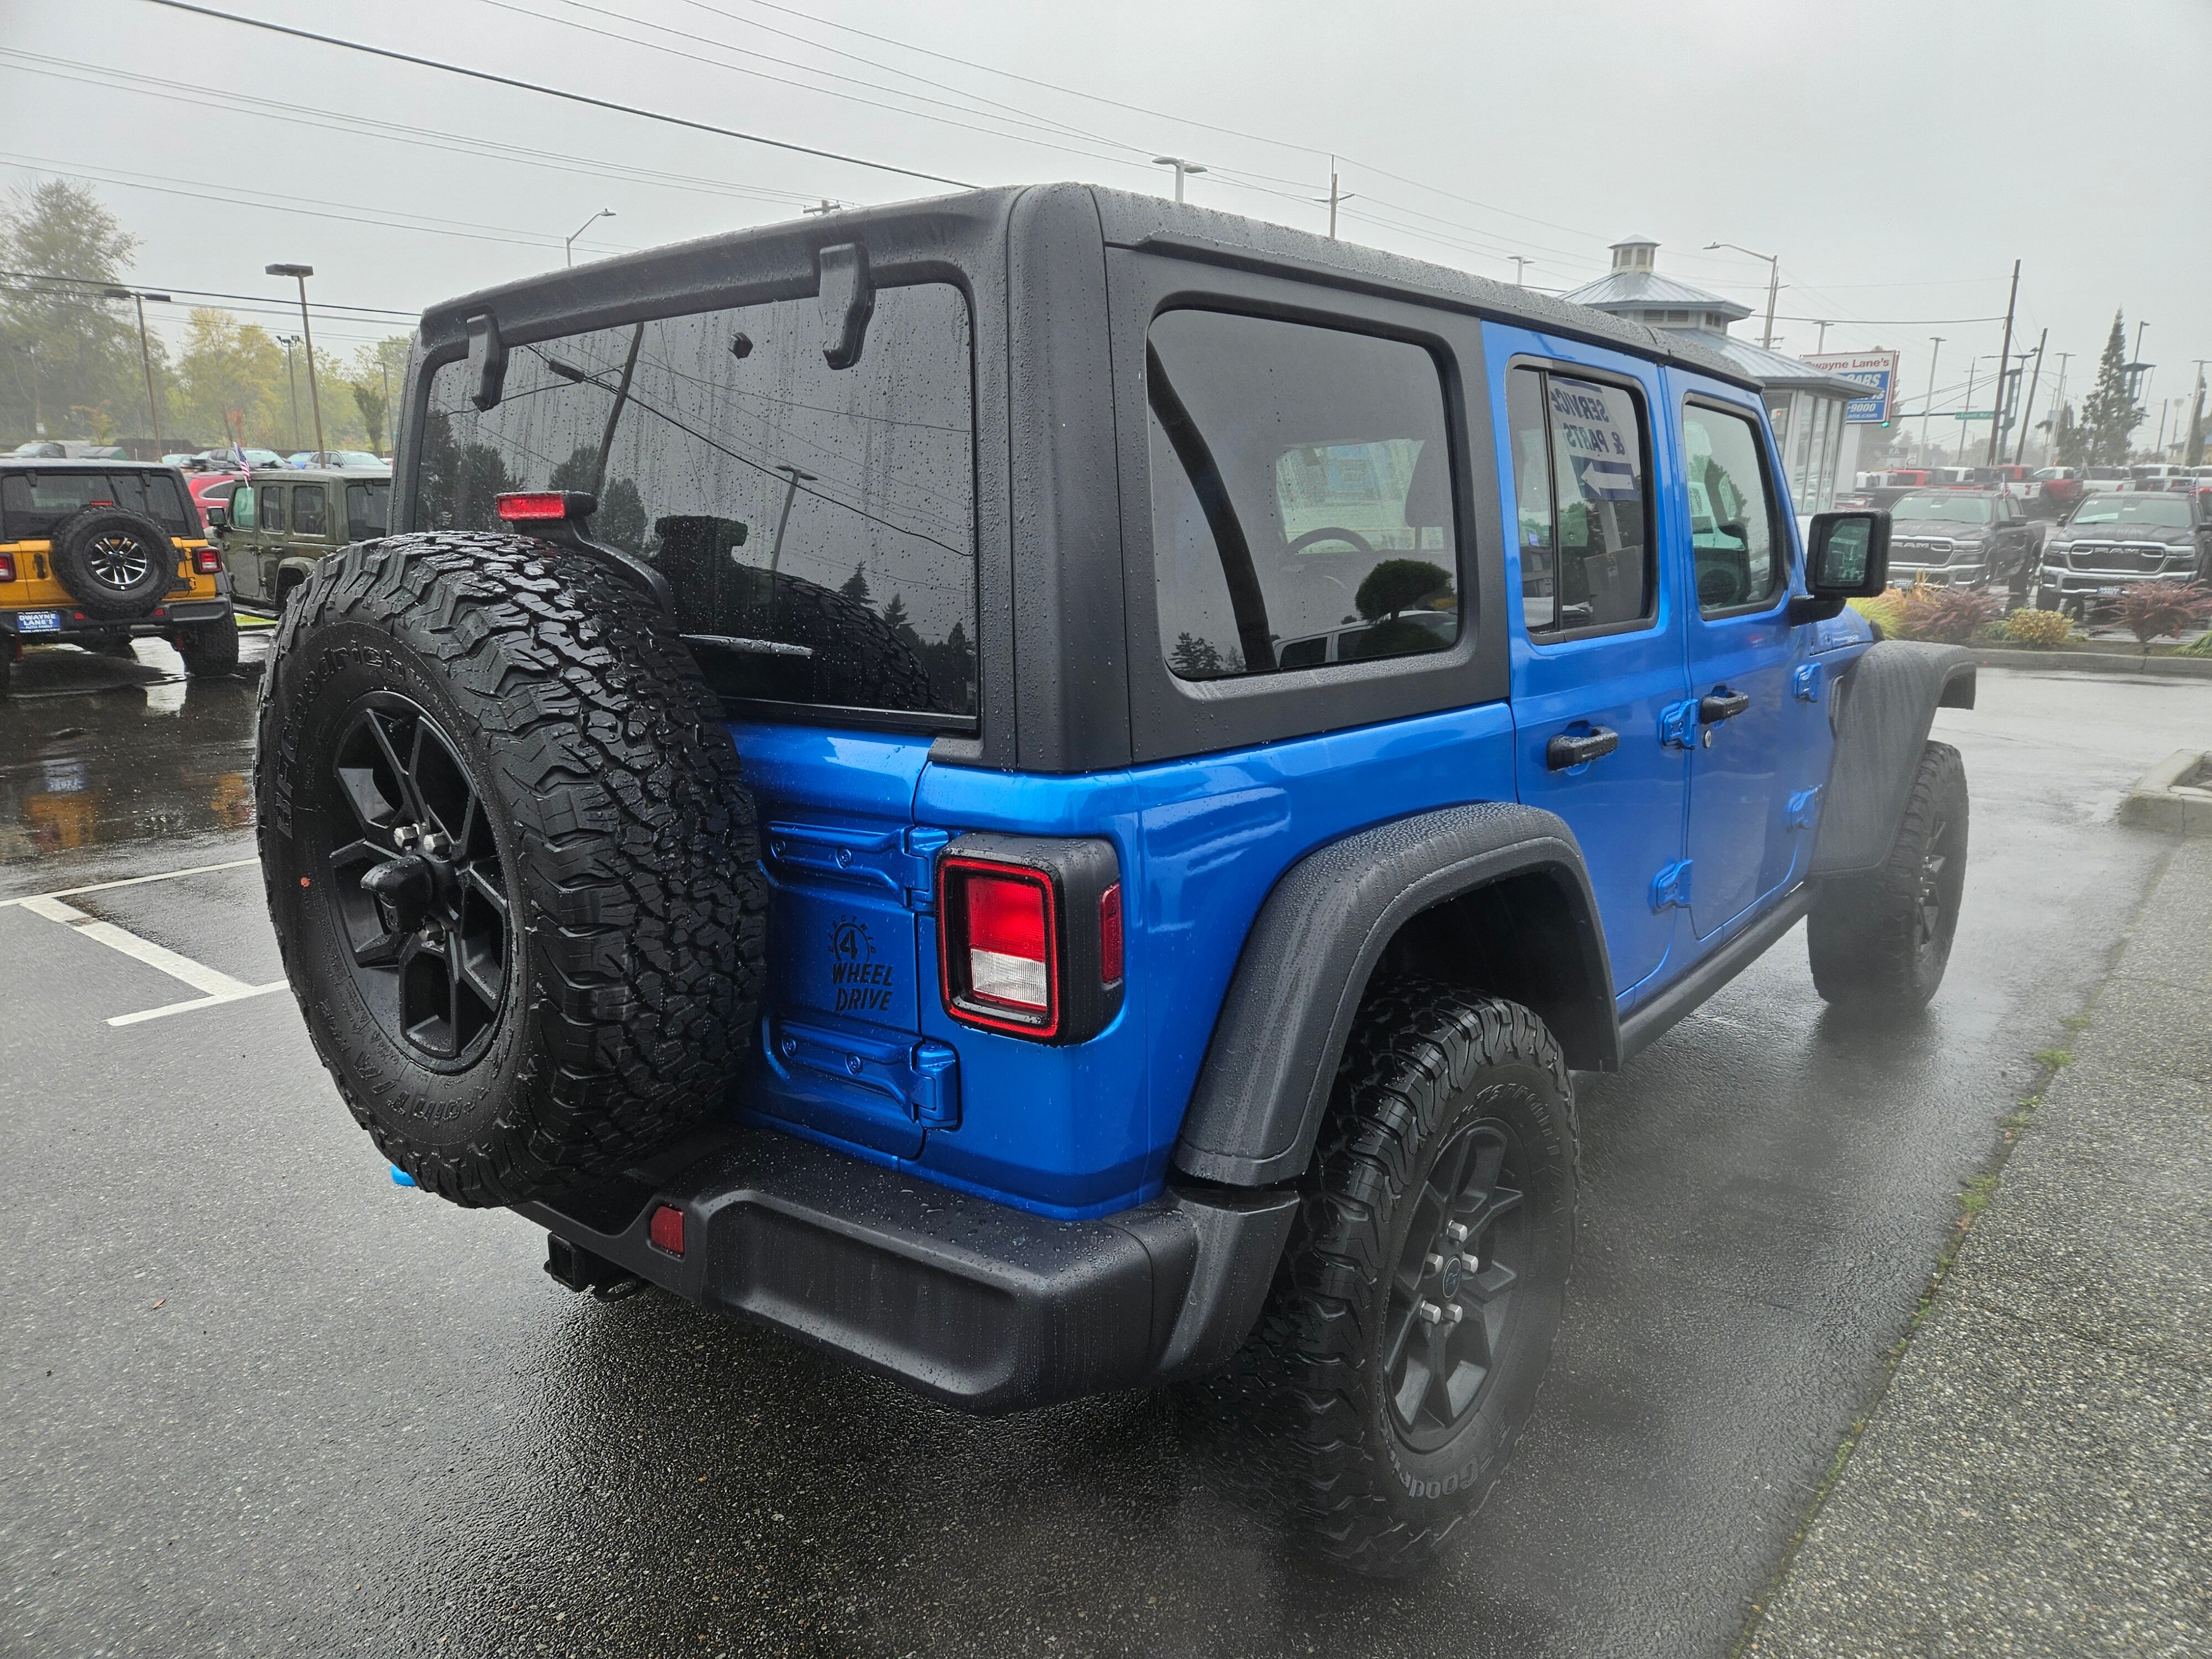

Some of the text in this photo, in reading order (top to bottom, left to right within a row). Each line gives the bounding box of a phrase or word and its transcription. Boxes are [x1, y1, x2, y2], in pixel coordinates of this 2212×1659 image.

[1853, 358, 1890, 368] Lane's
[839, 929, 859, 961] 4
[832, 963, 894, 987] WHEEL
[835, 988, 894, 1012] DRIVE
